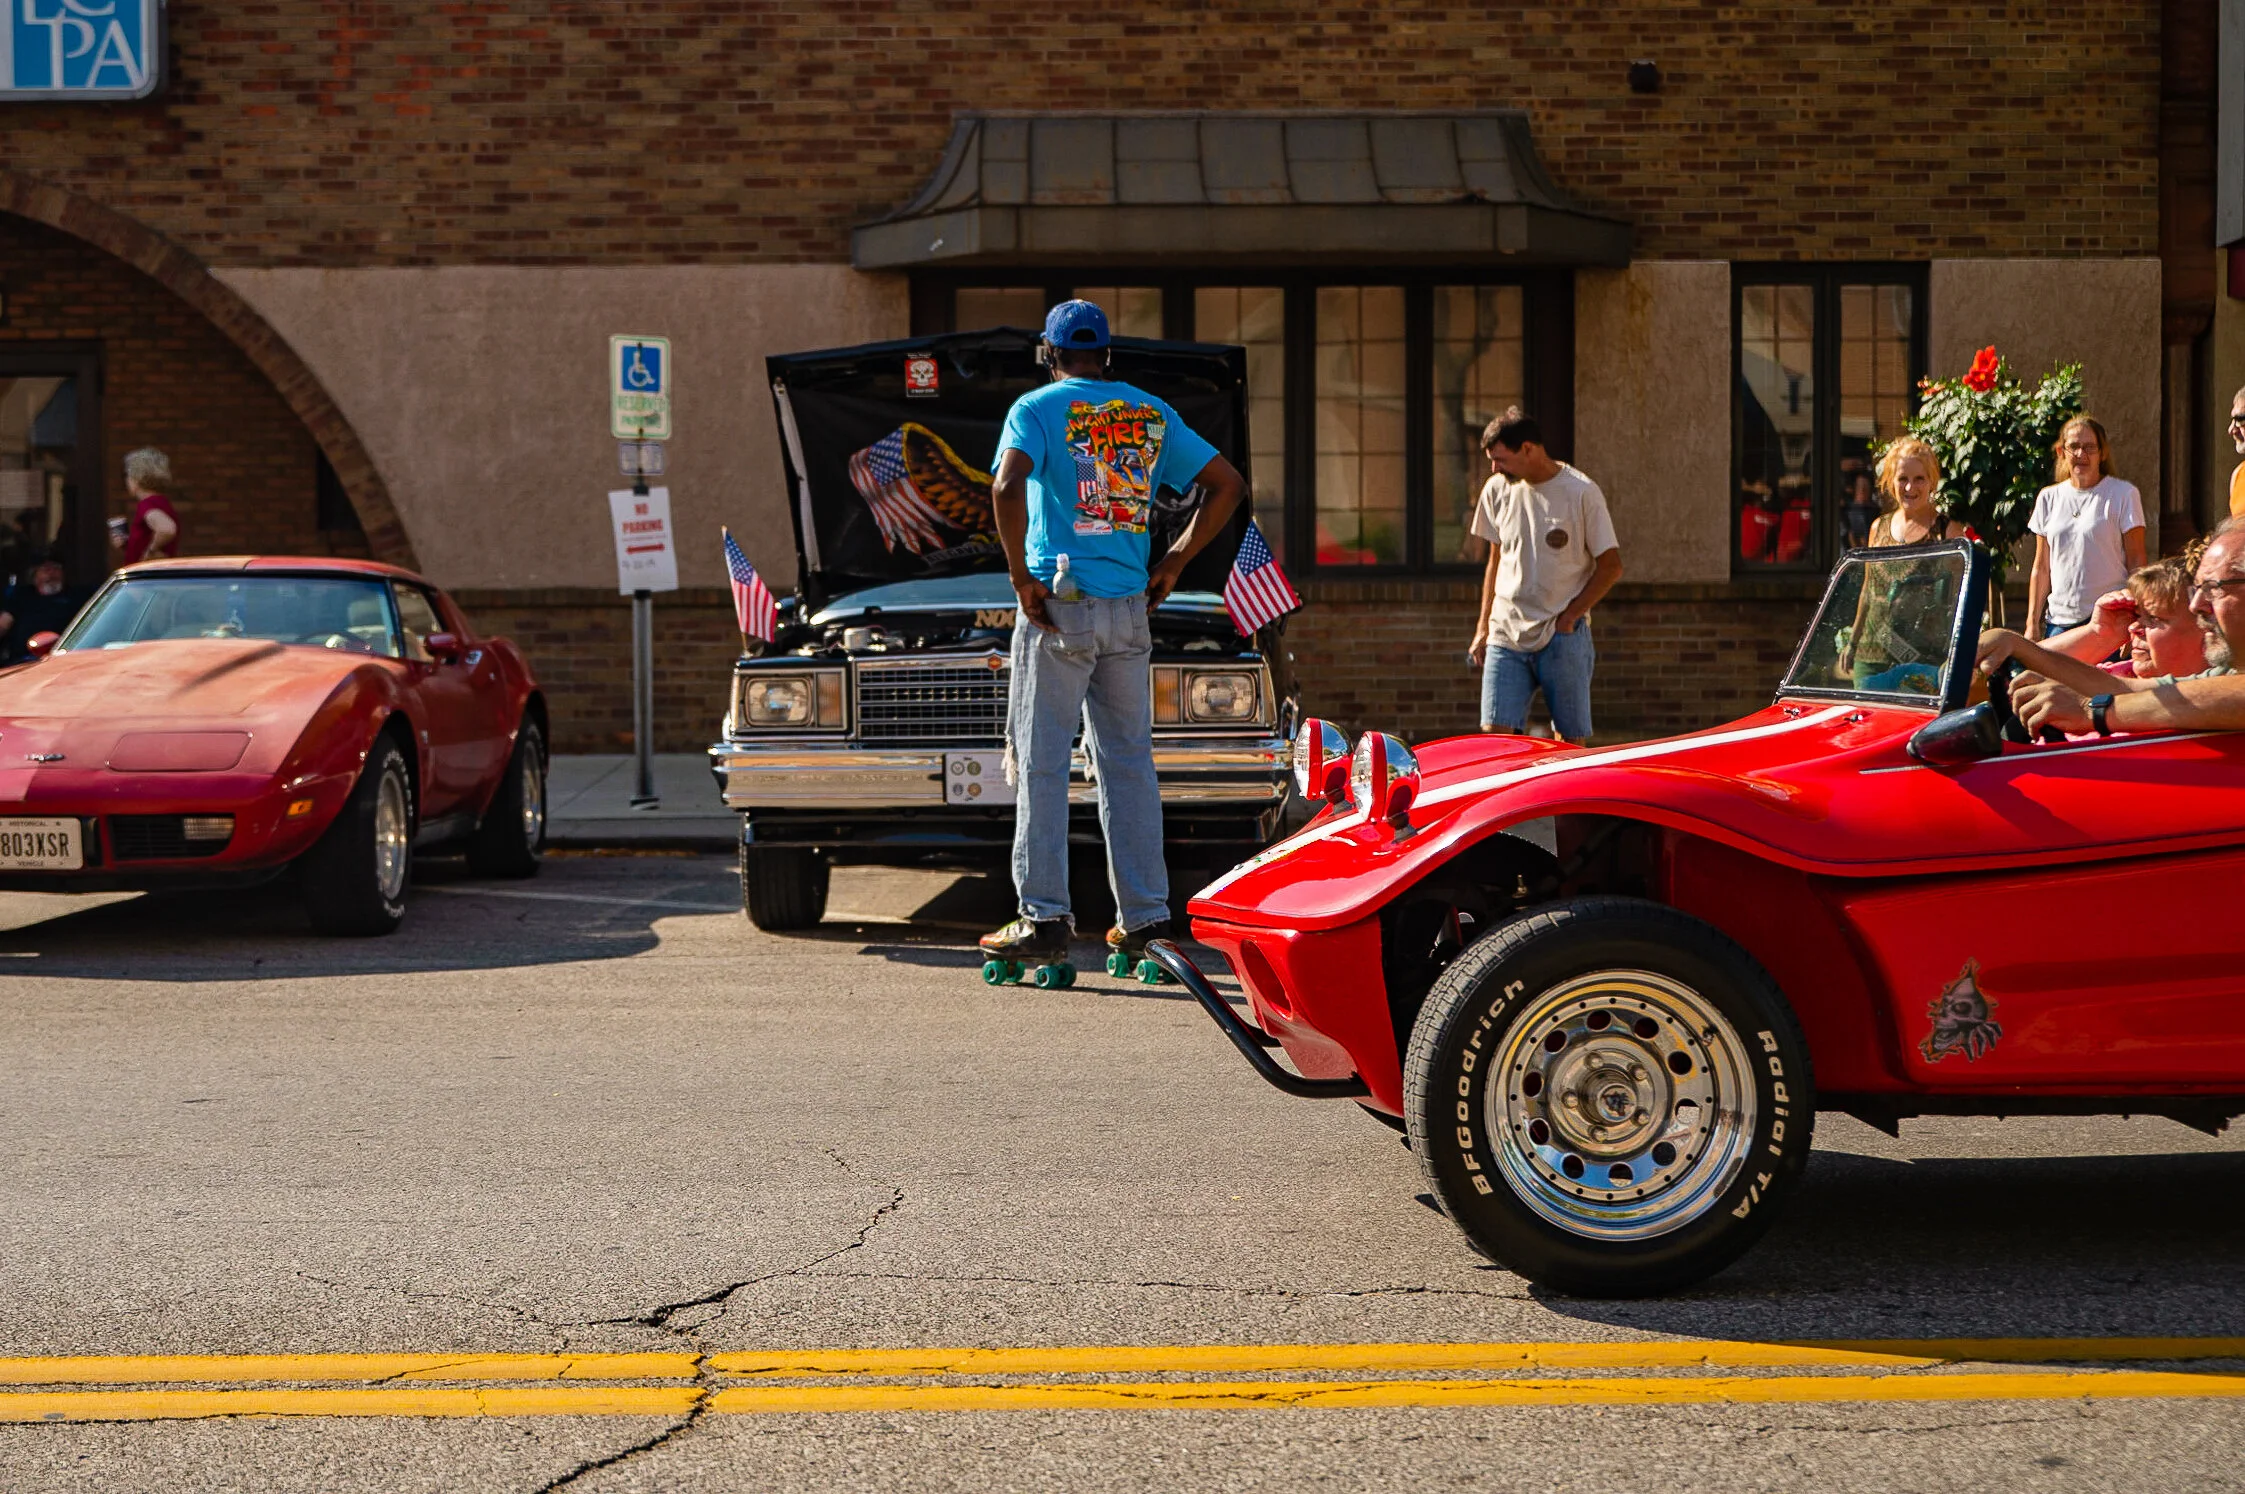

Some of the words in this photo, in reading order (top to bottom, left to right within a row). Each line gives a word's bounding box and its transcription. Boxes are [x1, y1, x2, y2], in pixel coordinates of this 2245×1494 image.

[1088, 421, 1146, 452] FIRE
[634, 503, 649, 515] NO
[622, 519, 663, 533] PARKING
[1, 832, 70, 857] 803XSR
[1456, 979, 1525, 1196] BFGoodrich
[1757, 1030, 1790, 1157] Radial
